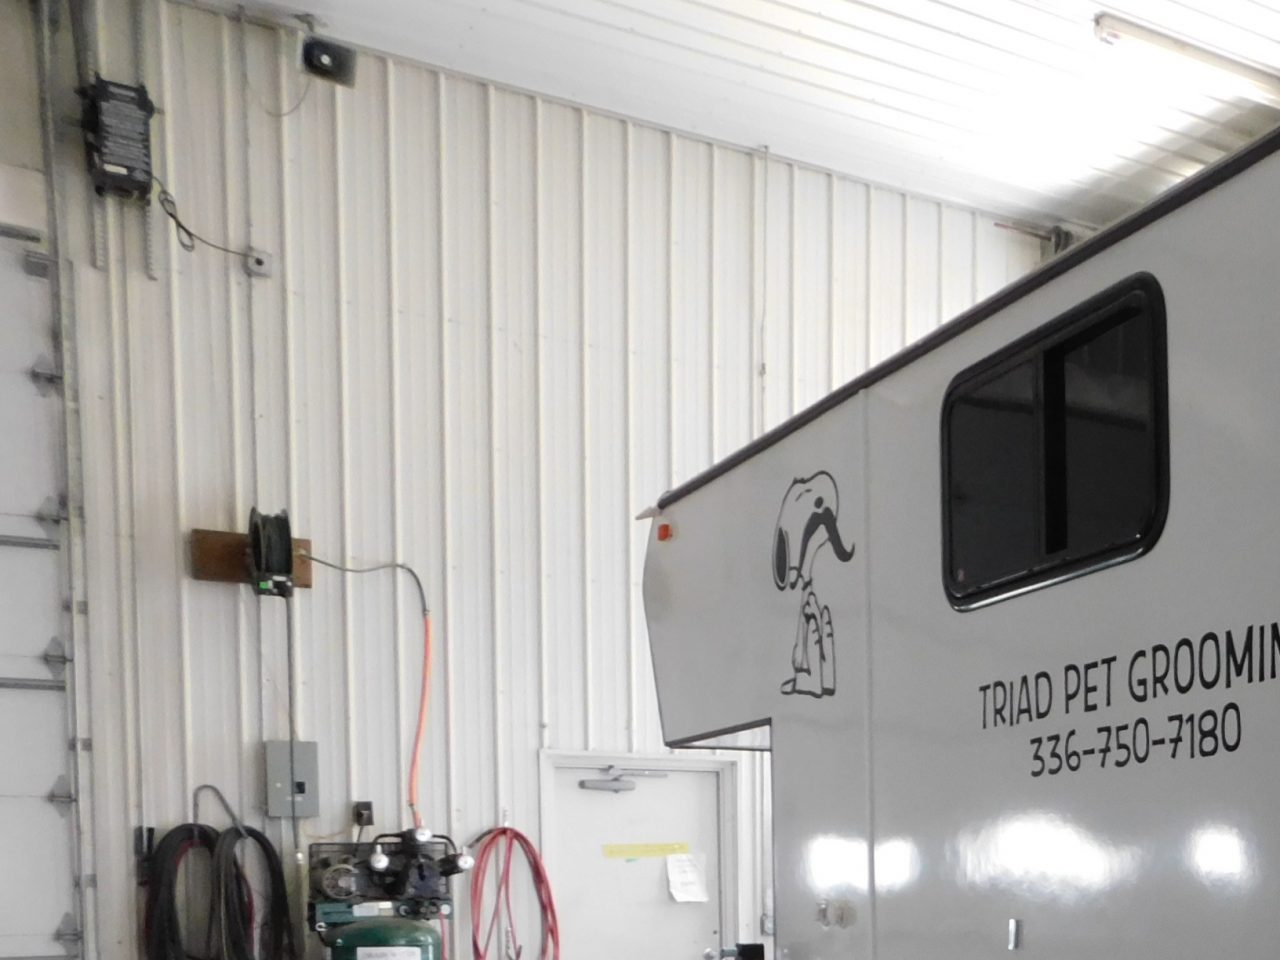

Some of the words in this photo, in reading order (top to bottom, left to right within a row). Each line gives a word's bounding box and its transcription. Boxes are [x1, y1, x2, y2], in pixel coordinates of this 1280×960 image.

[978, 671, 1053, 730] TRIAD
[1063, 656, 1118, 715] PET
[1029, 702, 1242, 778] 336-750-7180
